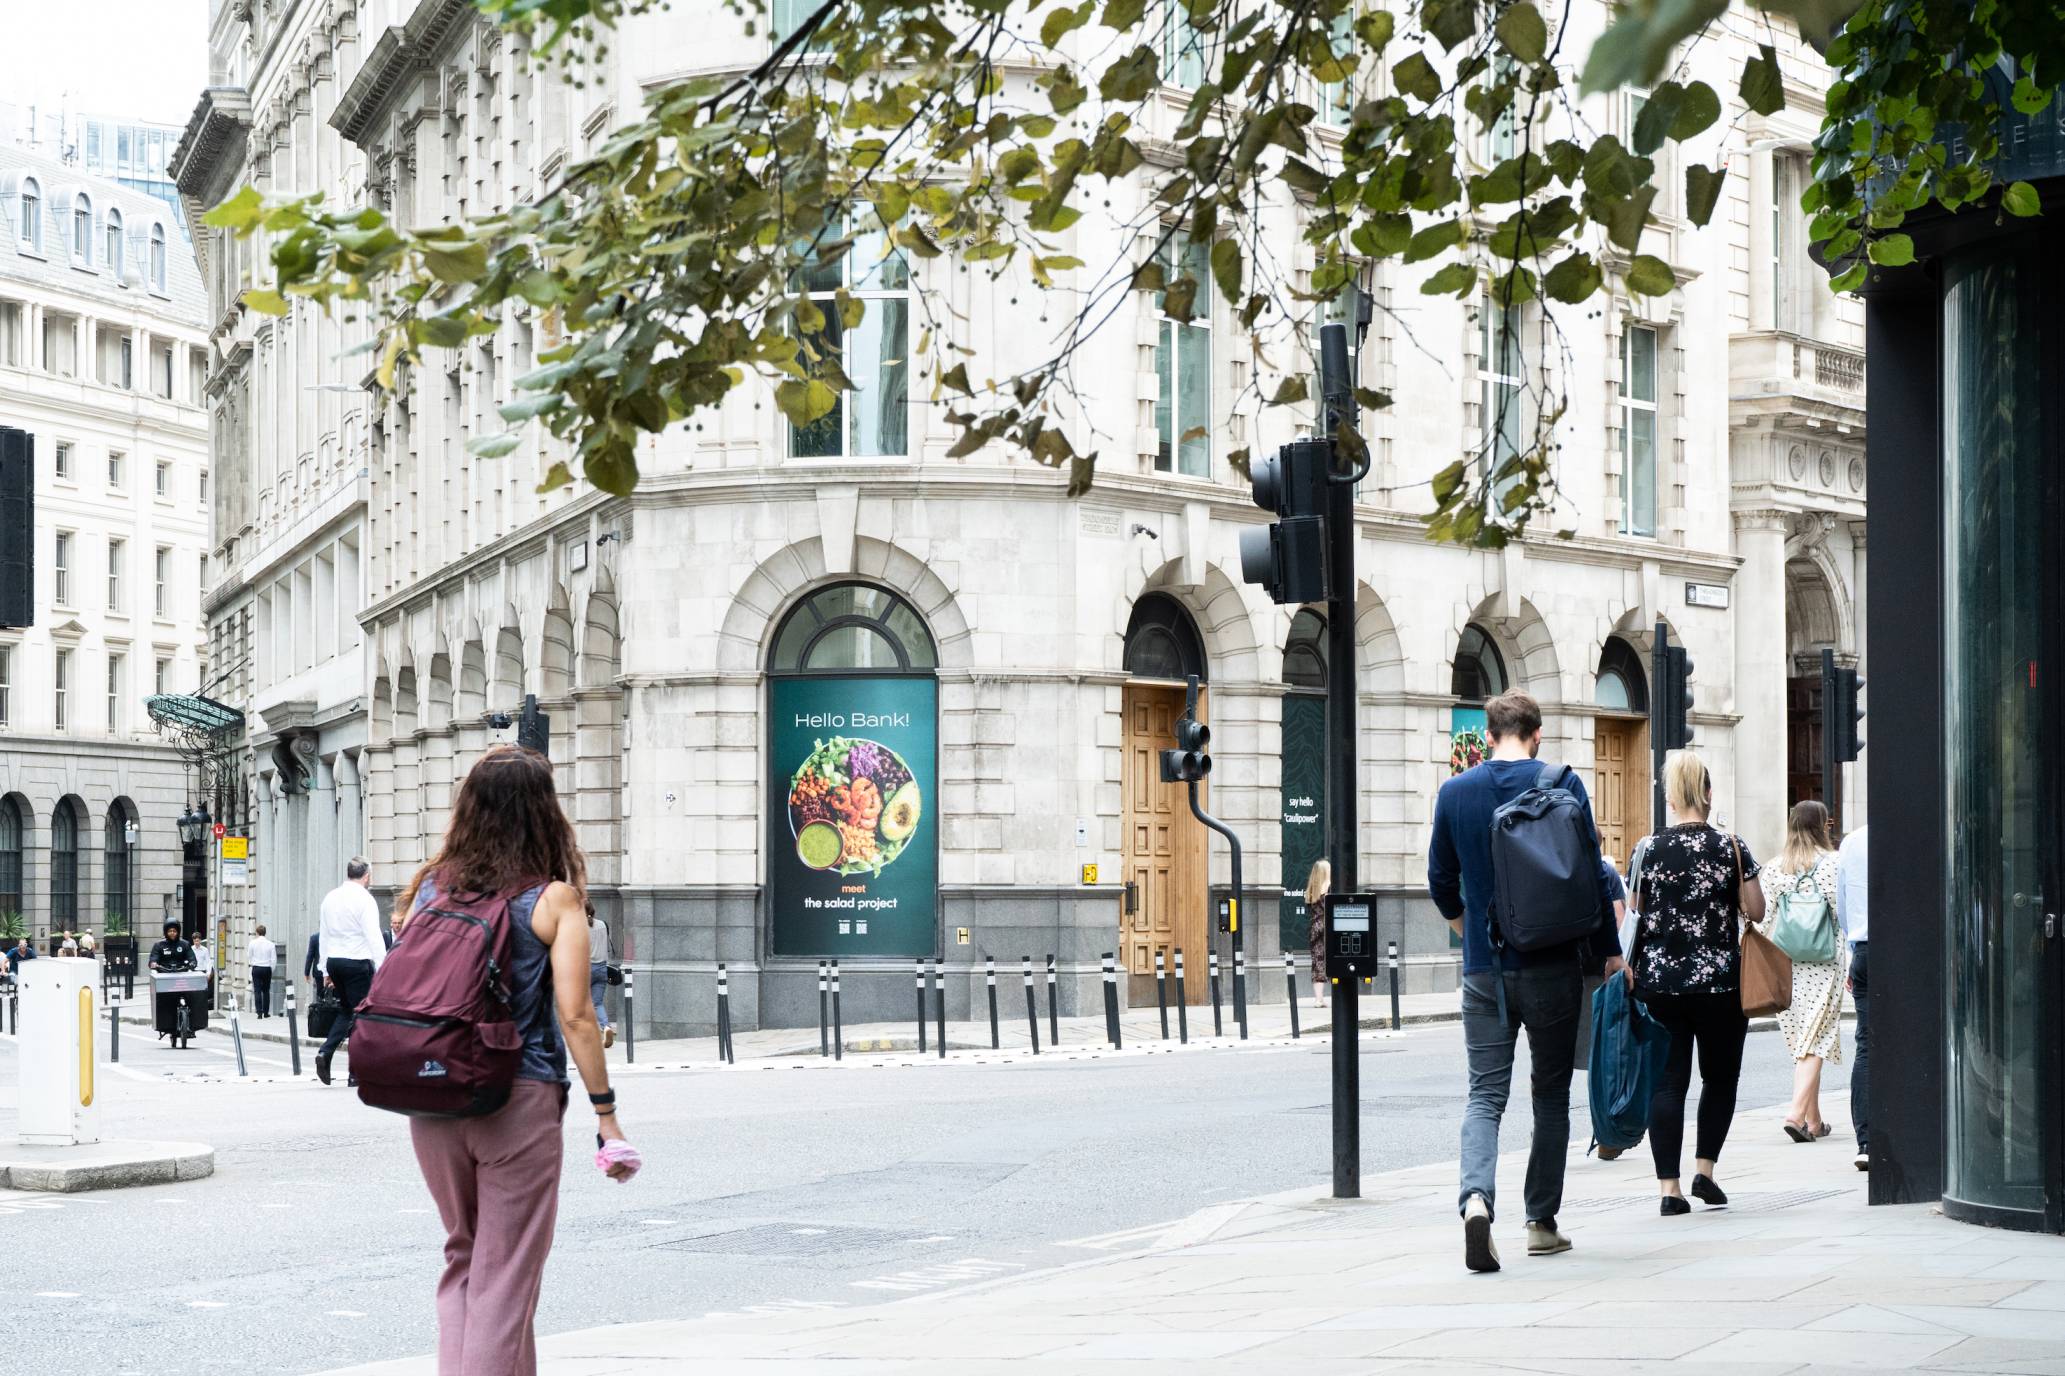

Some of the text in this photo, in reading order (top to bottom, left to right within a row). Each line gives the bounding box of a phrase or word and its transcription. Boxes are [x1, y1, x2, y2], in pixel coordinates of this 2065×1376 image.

[796, 712, 910, 728] Hello Bank!
[1289, 797, 1313, 808] say hello
[842, 884, 866, 893] meet
[805, 897, 898, 911] the salad project
[958, 930, 969, 943] H
